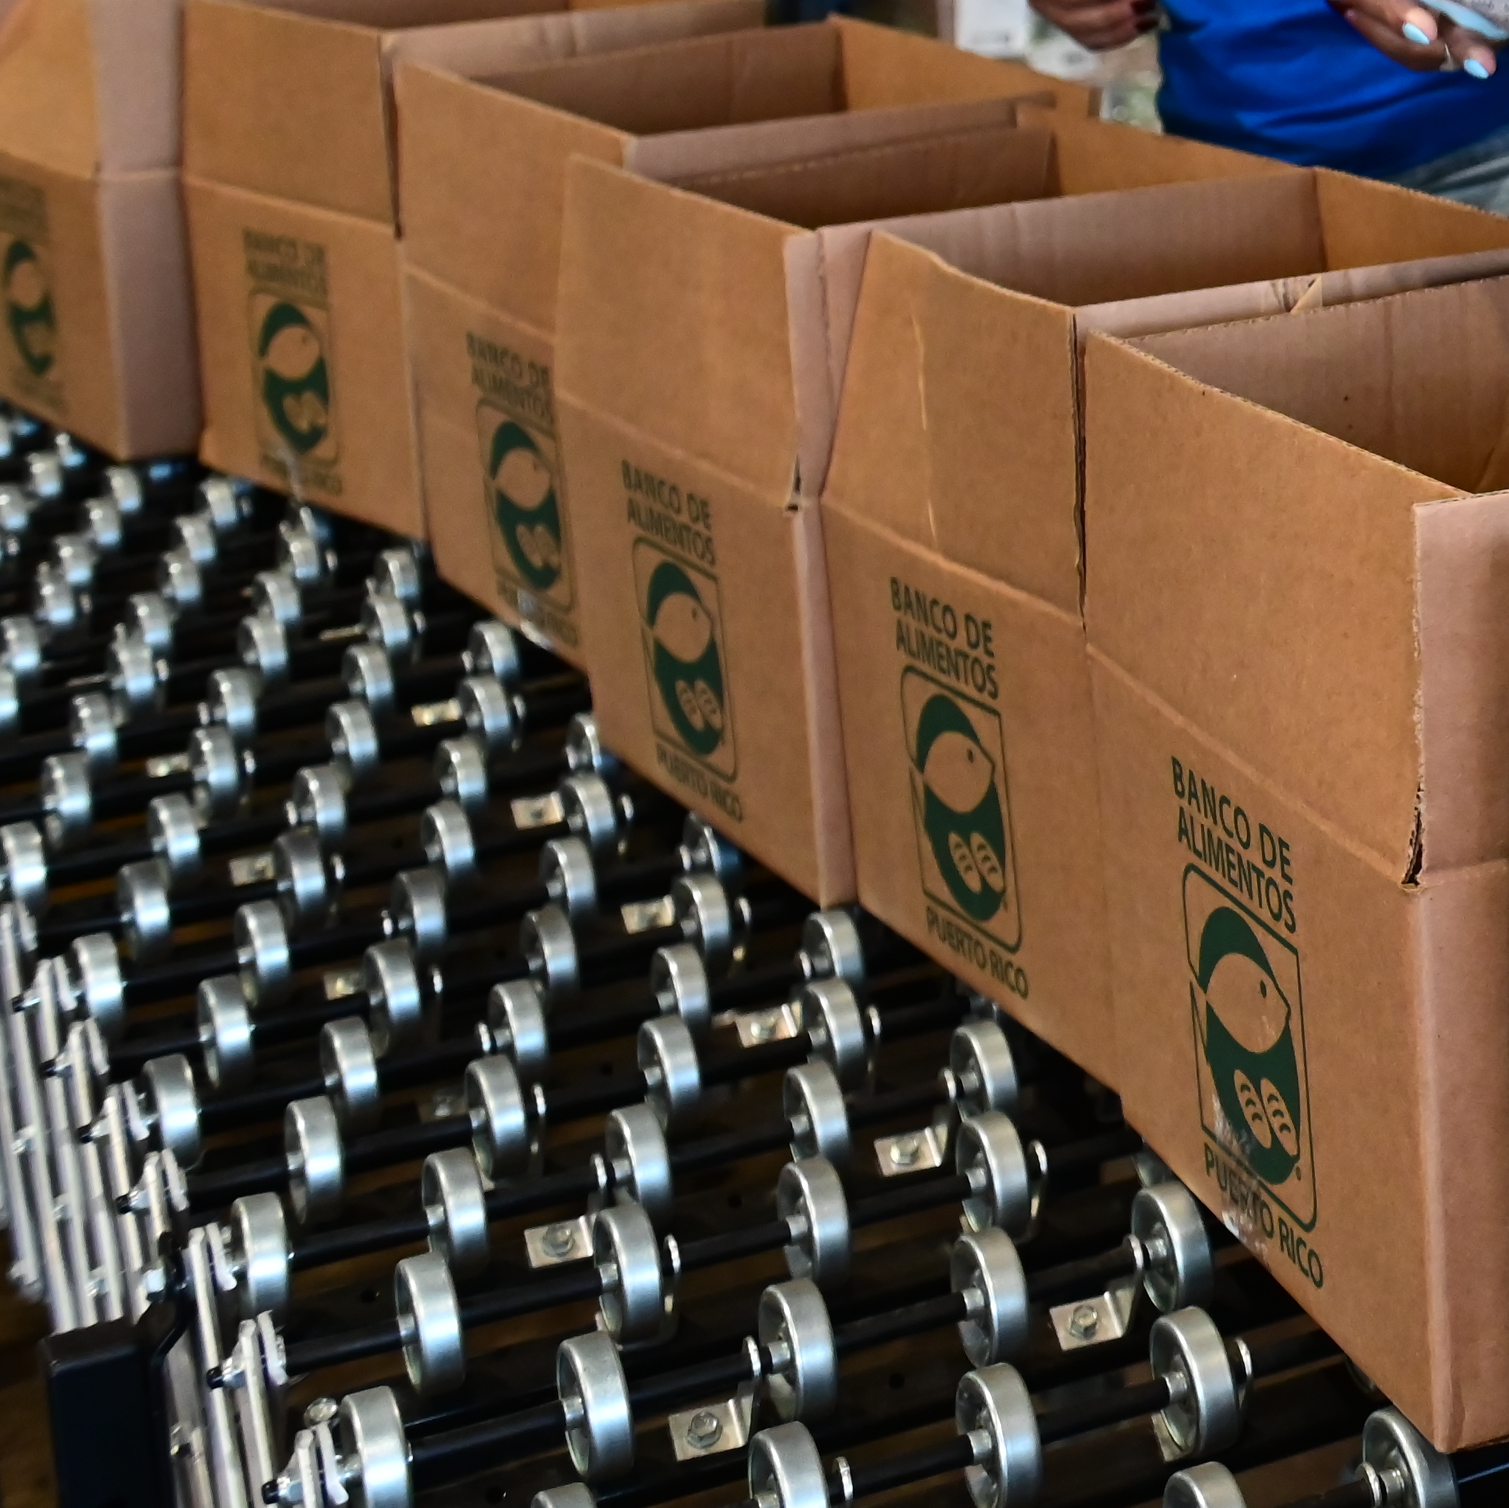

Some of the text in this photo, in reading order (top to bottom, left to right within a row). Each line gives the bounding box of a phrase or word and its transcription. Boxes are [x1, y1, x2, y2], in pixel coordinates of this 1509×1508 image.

[621, 458, 713, 531] BANCO DE
[627, 496, 717, 567] ALIMENTOS
[890, 576, 995, 659] BANCO DE
[895, 623, 999, 700] ALIMENTOS
[656, 742, 744, 825] PUERTO RICO
[1171, 756, 1293, 886] BANCO DE
[1177, 807, 1297, 935] ALIMENTOS
[925, 913, 1030, 1001] PUERTO RICO
[1204, 1142, 1324, 1290] PUERTO RICO
